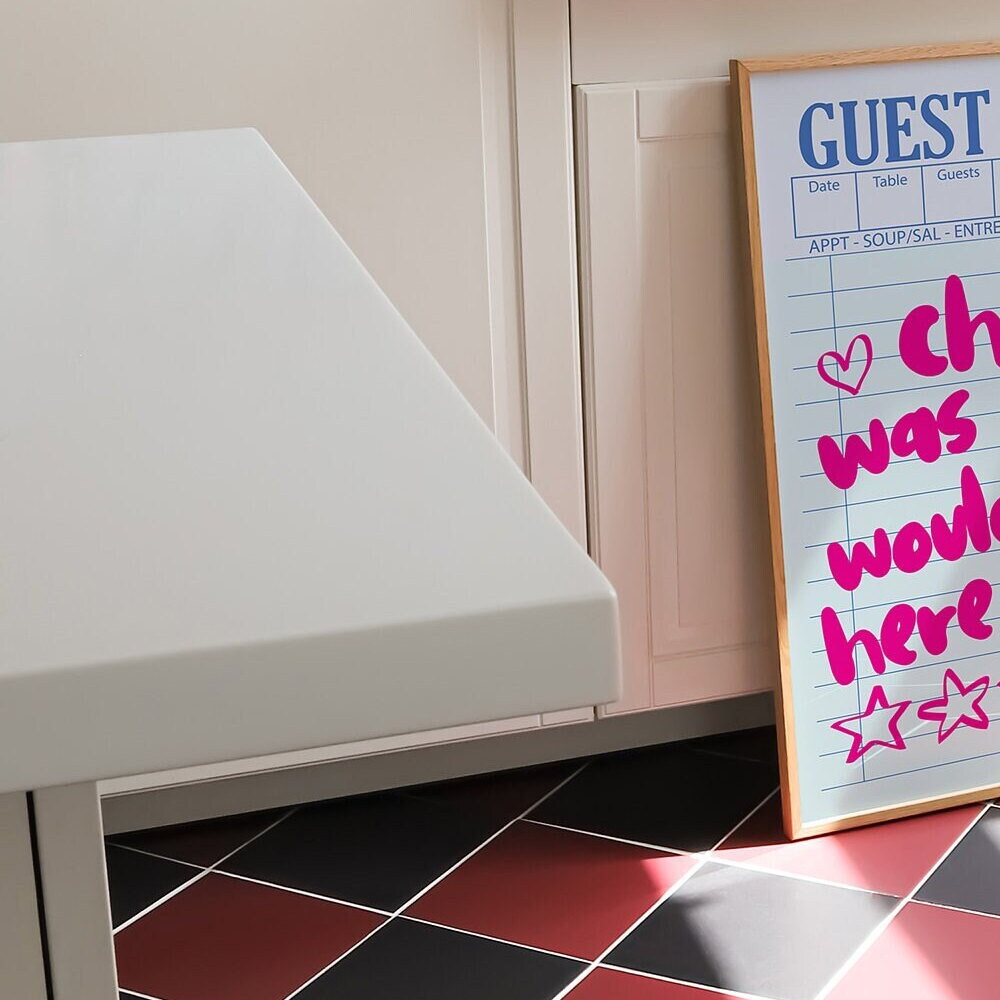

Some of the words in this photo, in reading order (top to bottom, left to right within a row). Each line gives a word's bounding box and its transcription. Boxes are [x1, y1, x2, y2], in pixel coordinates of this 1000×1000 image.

[799, 89, 991, 170] GUEST
[808, 180, 840, 193] Date
[873, 174, 908, 188] Table
[937, 167, 980, 181] Guests
[809, 236, 849, 254] APPT
[863, 227, 941, 249] SOUP/SAL
[818, 389, 977, 490] was
[821, 578, 993, 686] here
